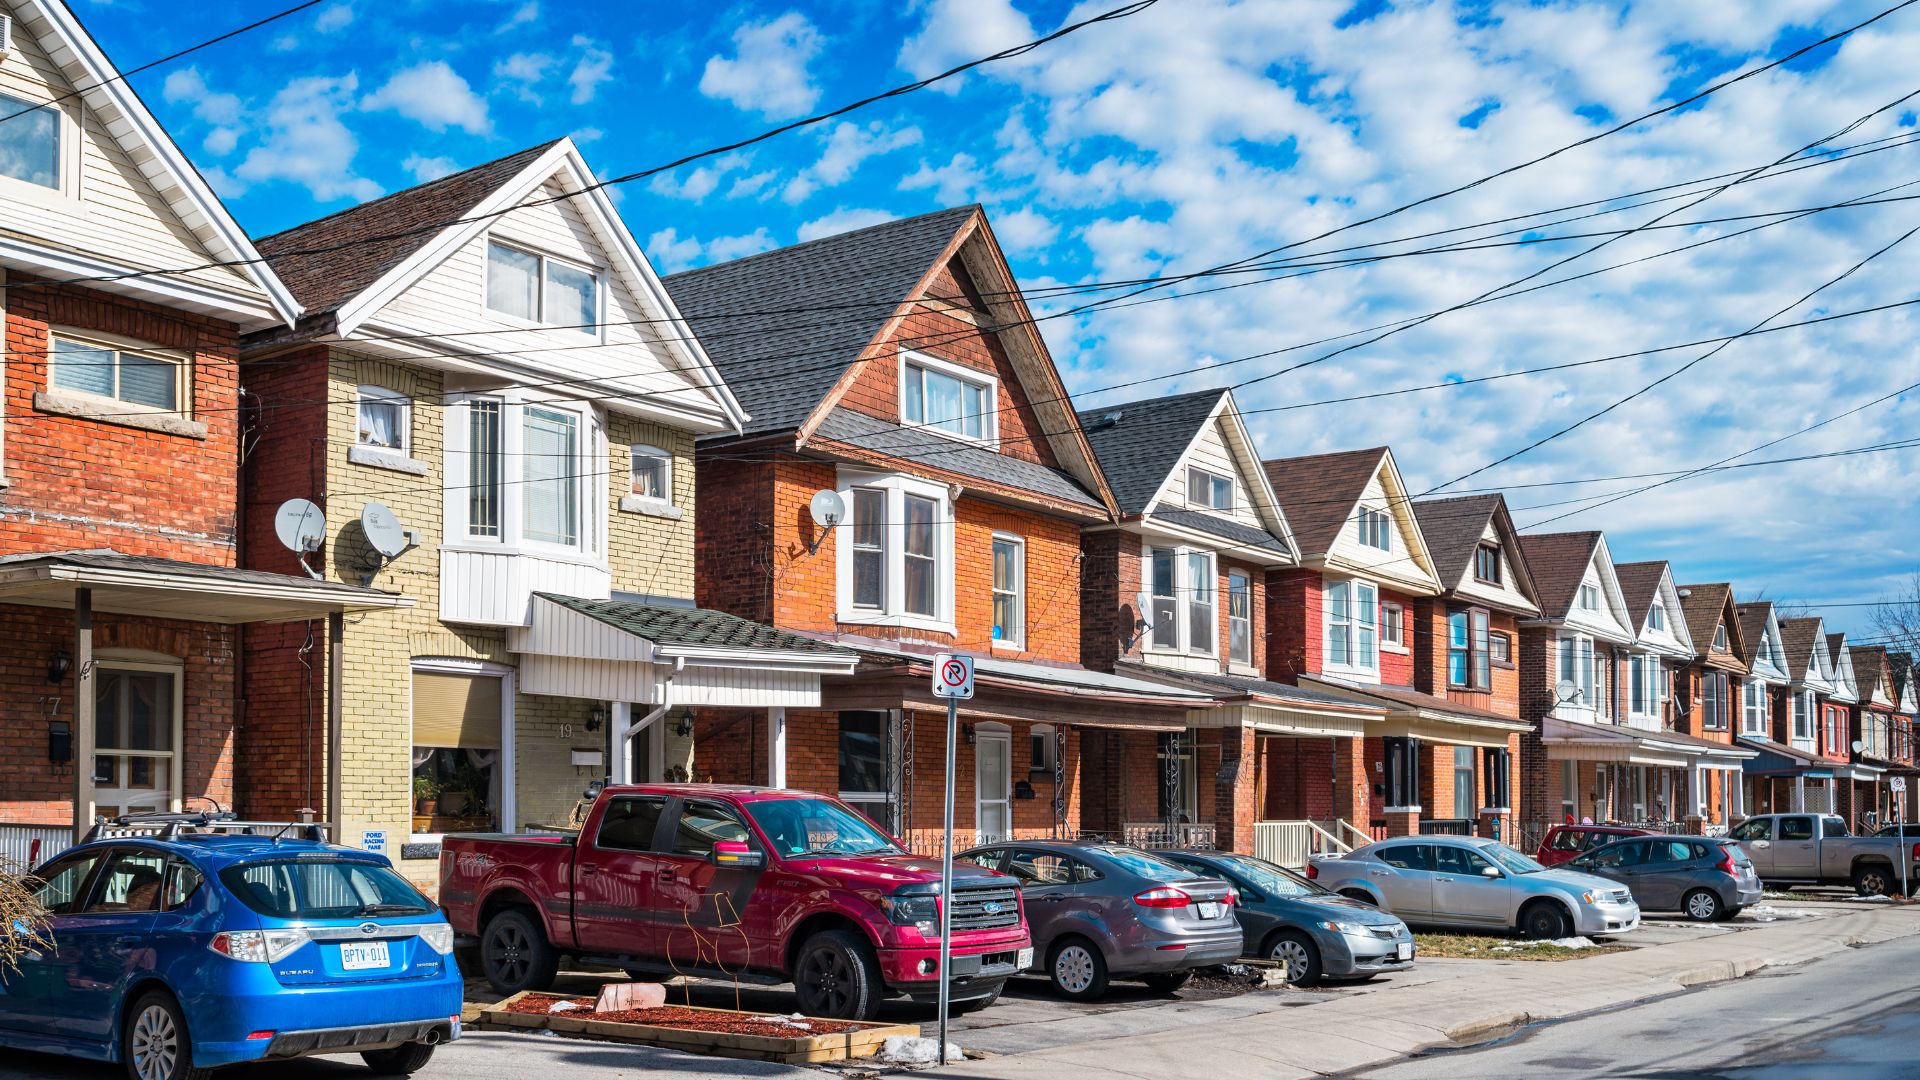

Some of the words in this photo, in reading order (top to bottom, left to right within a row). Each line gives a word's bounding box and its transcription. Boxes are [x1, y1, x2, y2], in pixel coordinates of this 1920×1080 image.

[38, 696, 62, 716] 17
[559, 723, 572, 738] 19
[344, 949, 366, 962] BPTV
